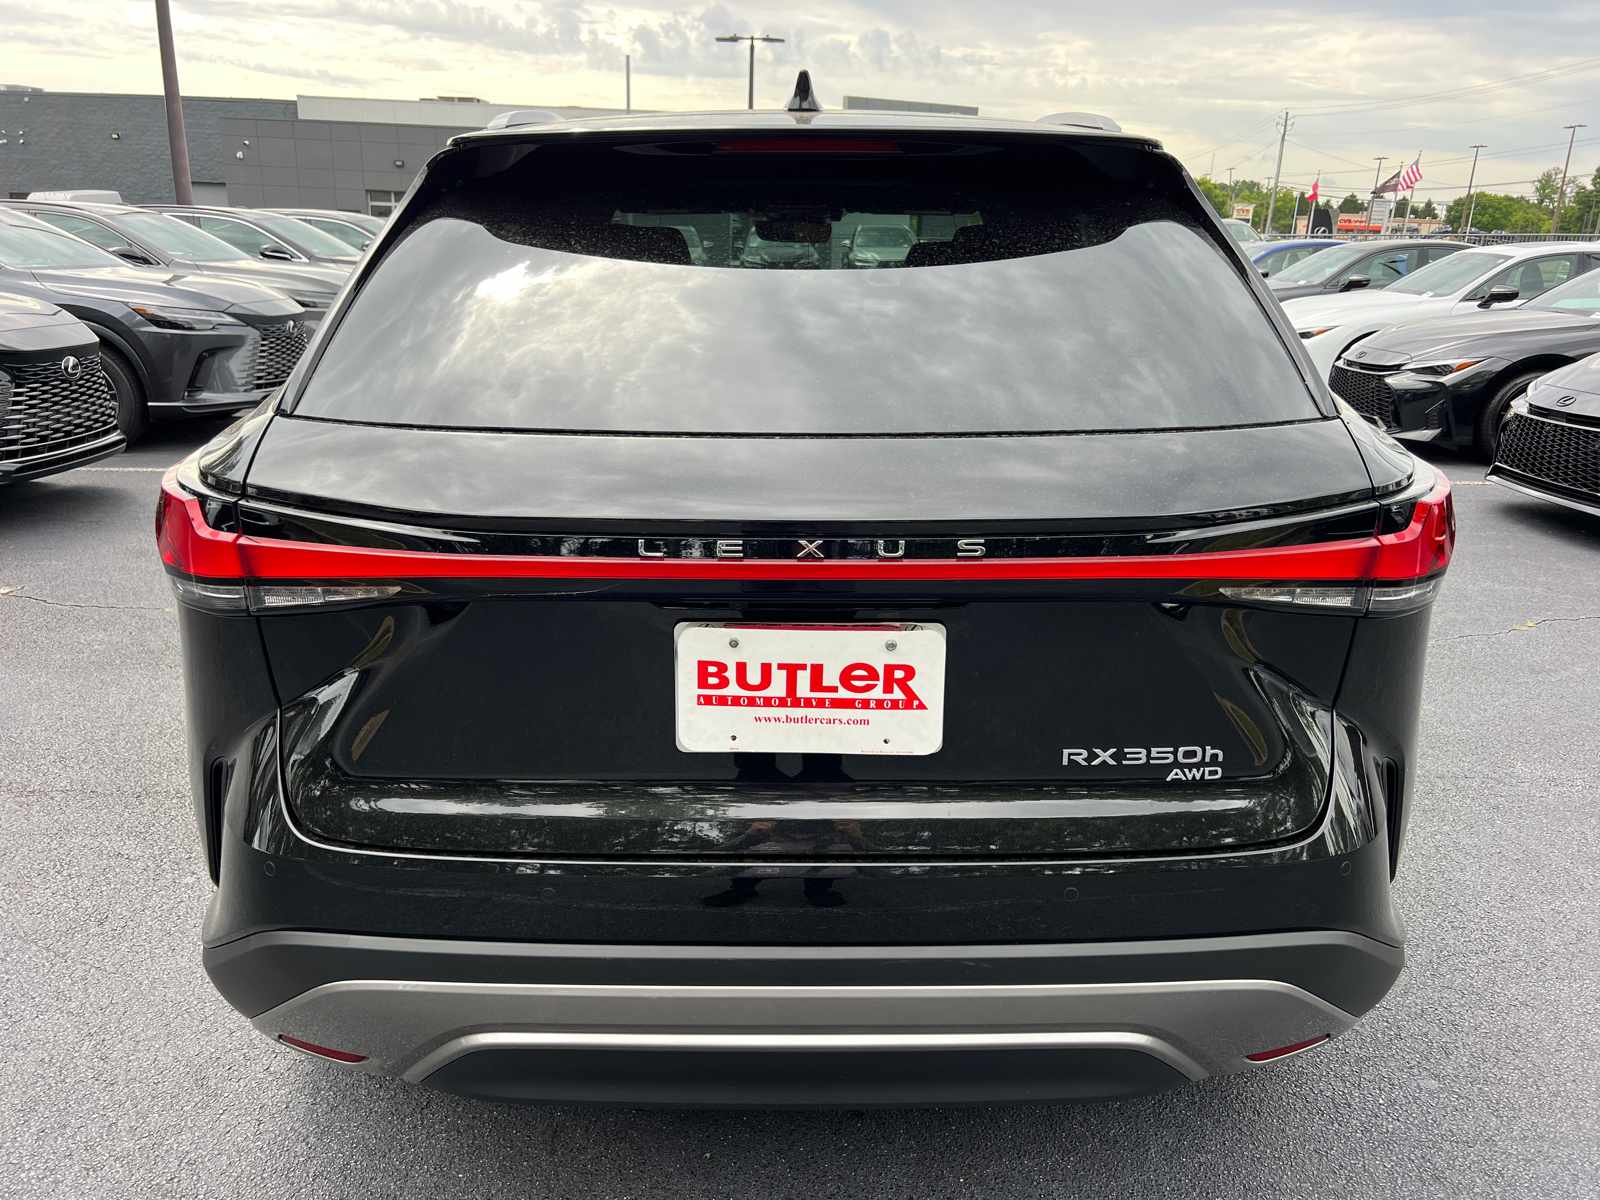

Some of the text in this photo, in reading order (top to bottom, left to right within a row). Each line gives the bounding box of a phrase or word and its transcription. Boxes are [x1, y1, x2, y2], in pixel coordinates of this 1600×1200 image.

[638, 539, 986, 558] LEXUS
[698, 695, 920, 710] AUTOMOTIVE GROUP
[753, 714, 870, 726] www.butlercars.com
[1165, 767, 1223, 782] AWD
